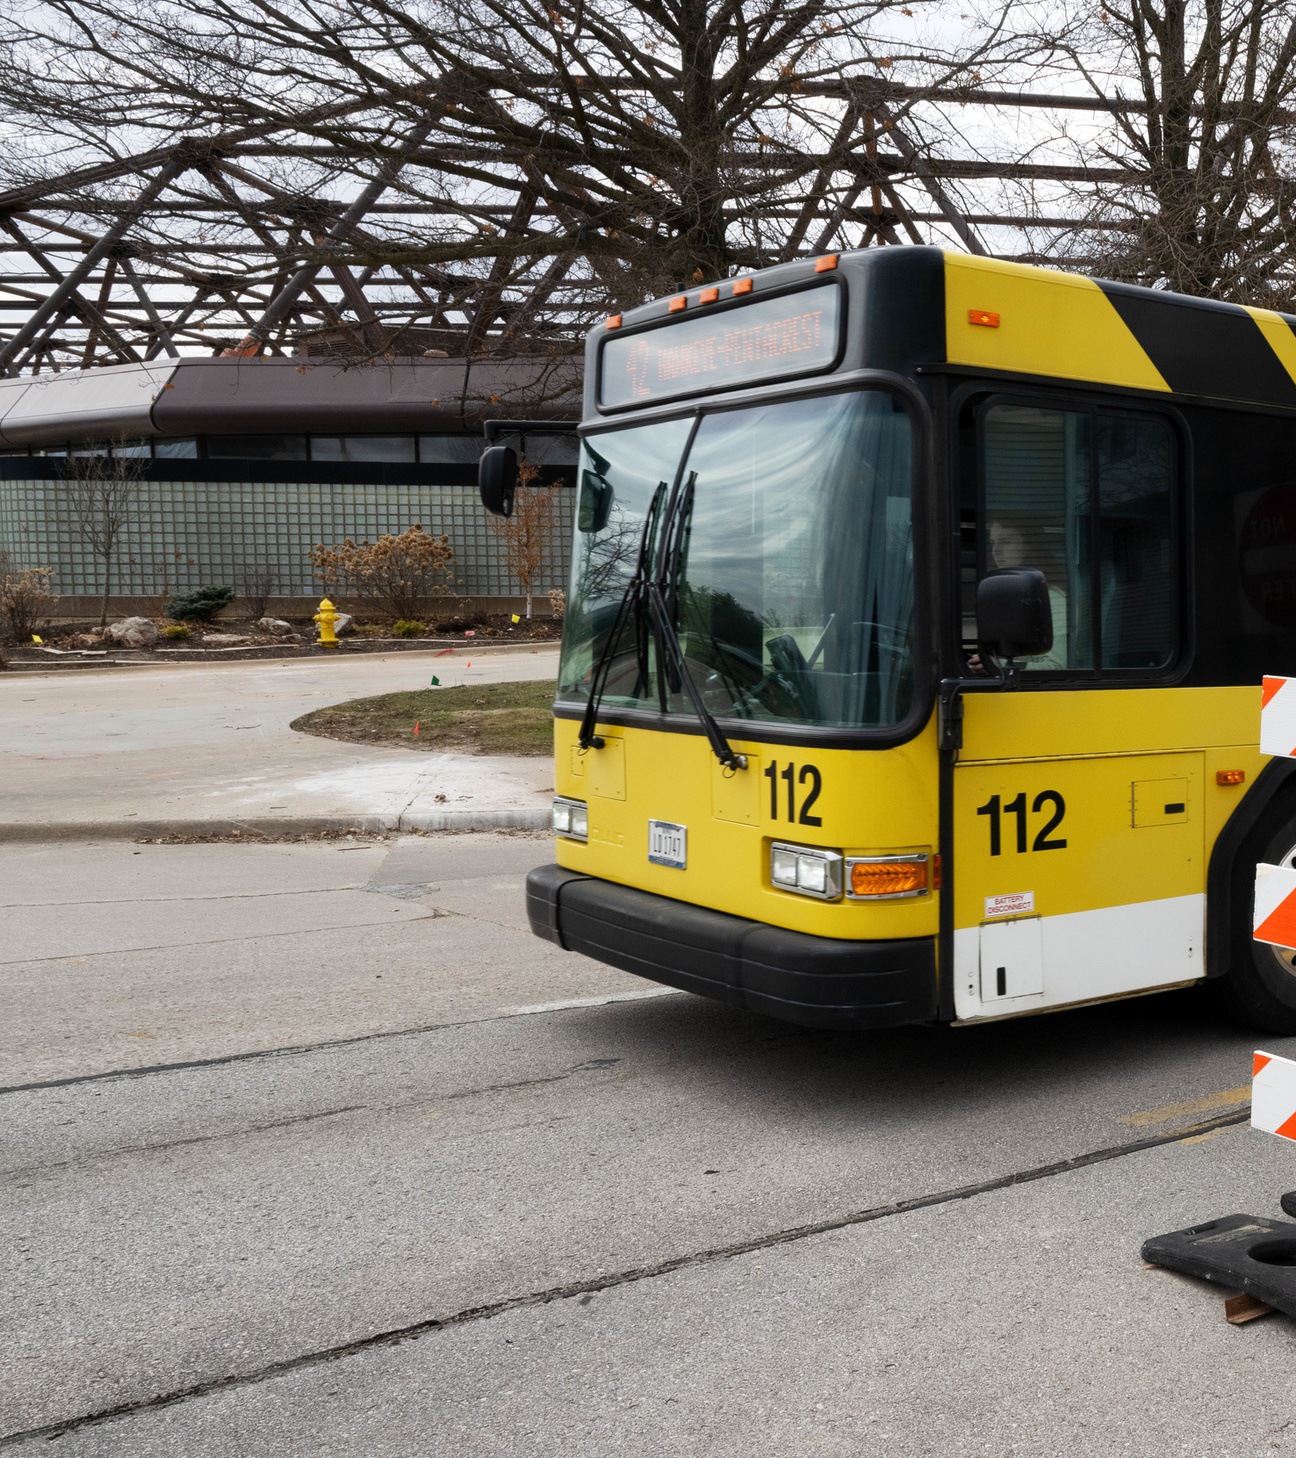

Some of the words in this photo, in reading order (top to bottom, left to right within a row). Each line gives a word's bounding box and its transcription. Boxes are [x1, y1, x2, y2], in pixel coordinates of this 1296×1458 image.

[764, 759, 823, 828] 112
[976, 789, 1067, 857] 112
[988, 901, 1032, 915] DISCONNECT
[994, 894, 1025, 906] BATTERY
